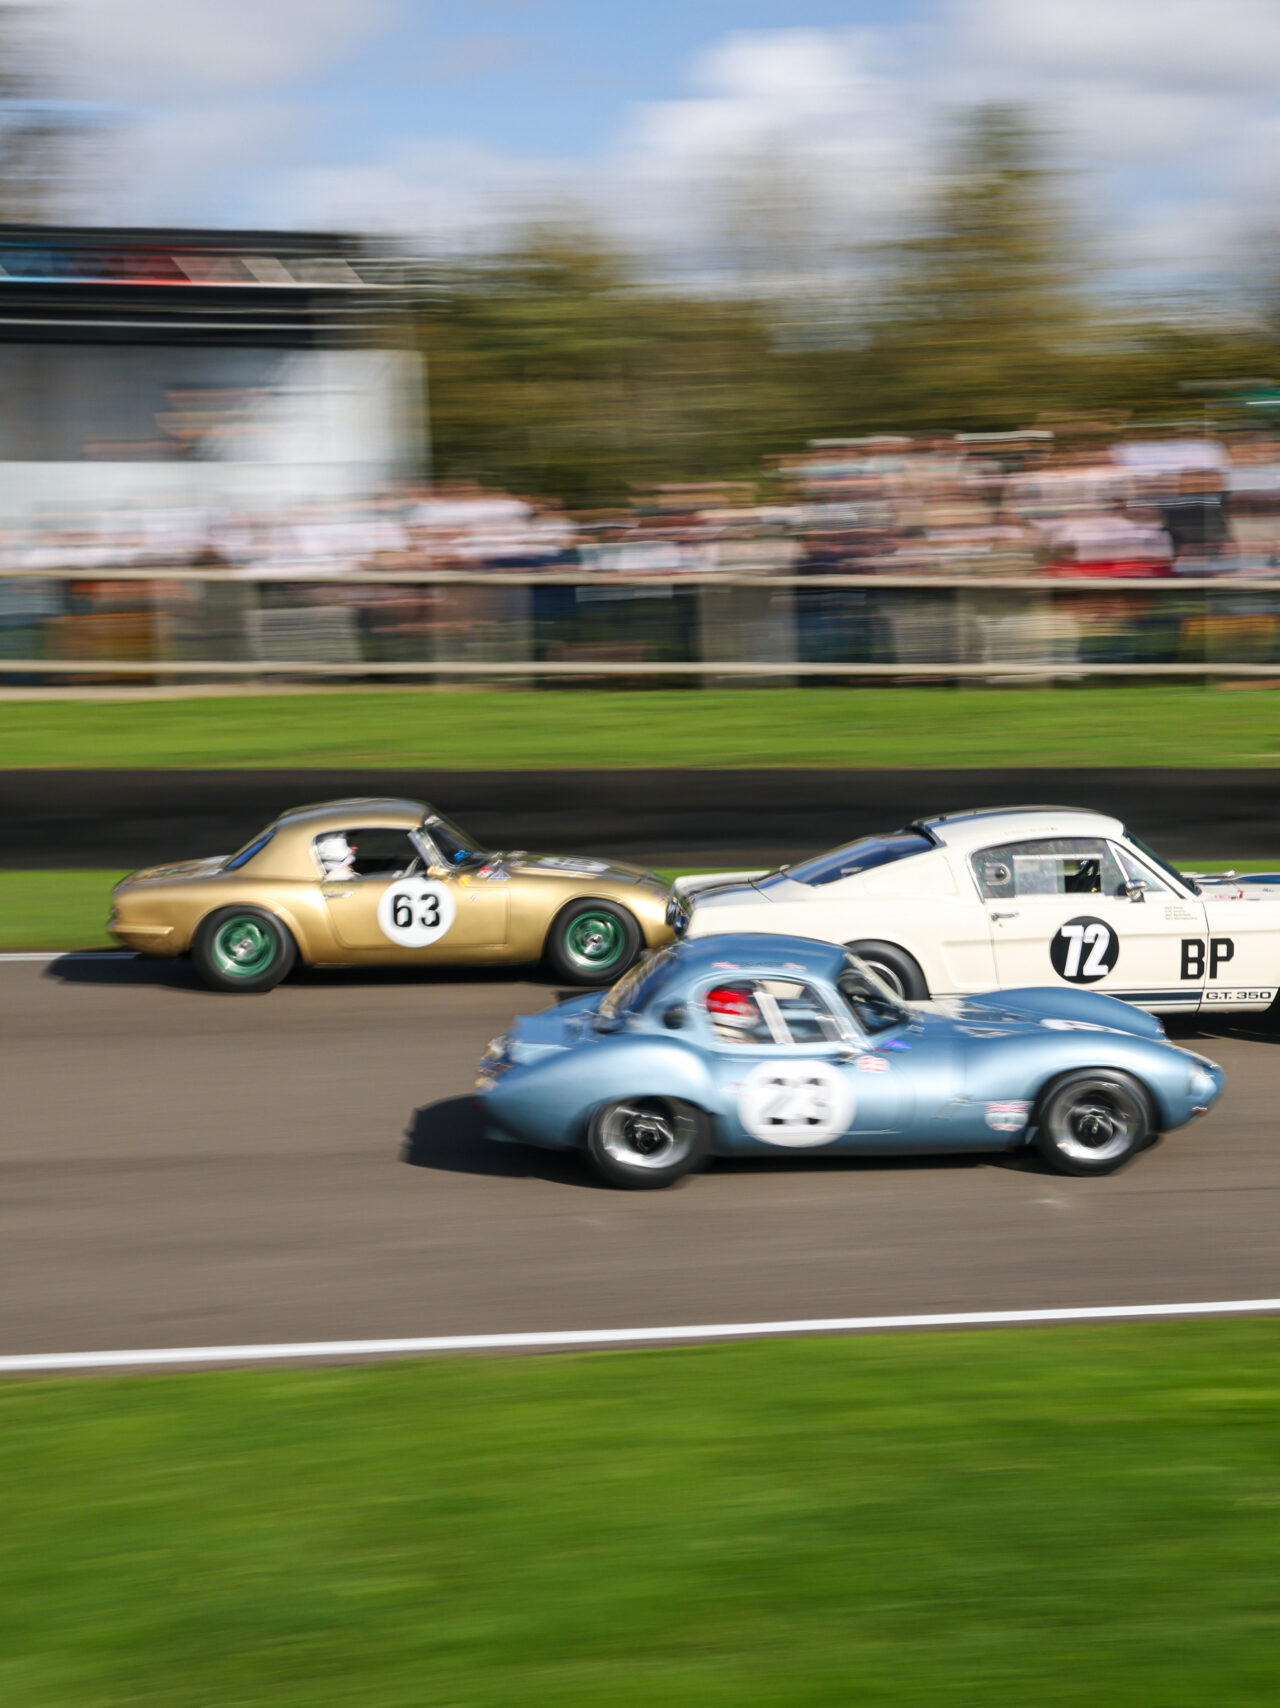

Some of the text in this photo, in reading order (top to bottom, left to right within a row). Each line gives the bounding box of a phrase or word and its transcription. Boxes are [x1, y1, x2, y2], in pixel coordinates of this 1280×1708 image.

[393, 893, 441, 928] 63
[1060, 923, 1111, 977] 72
[1180, 937, 1235, 980] BP
[1205, 991, 1272, 1000] G.T. 350
[759, 1077, 832, 1127] 23
